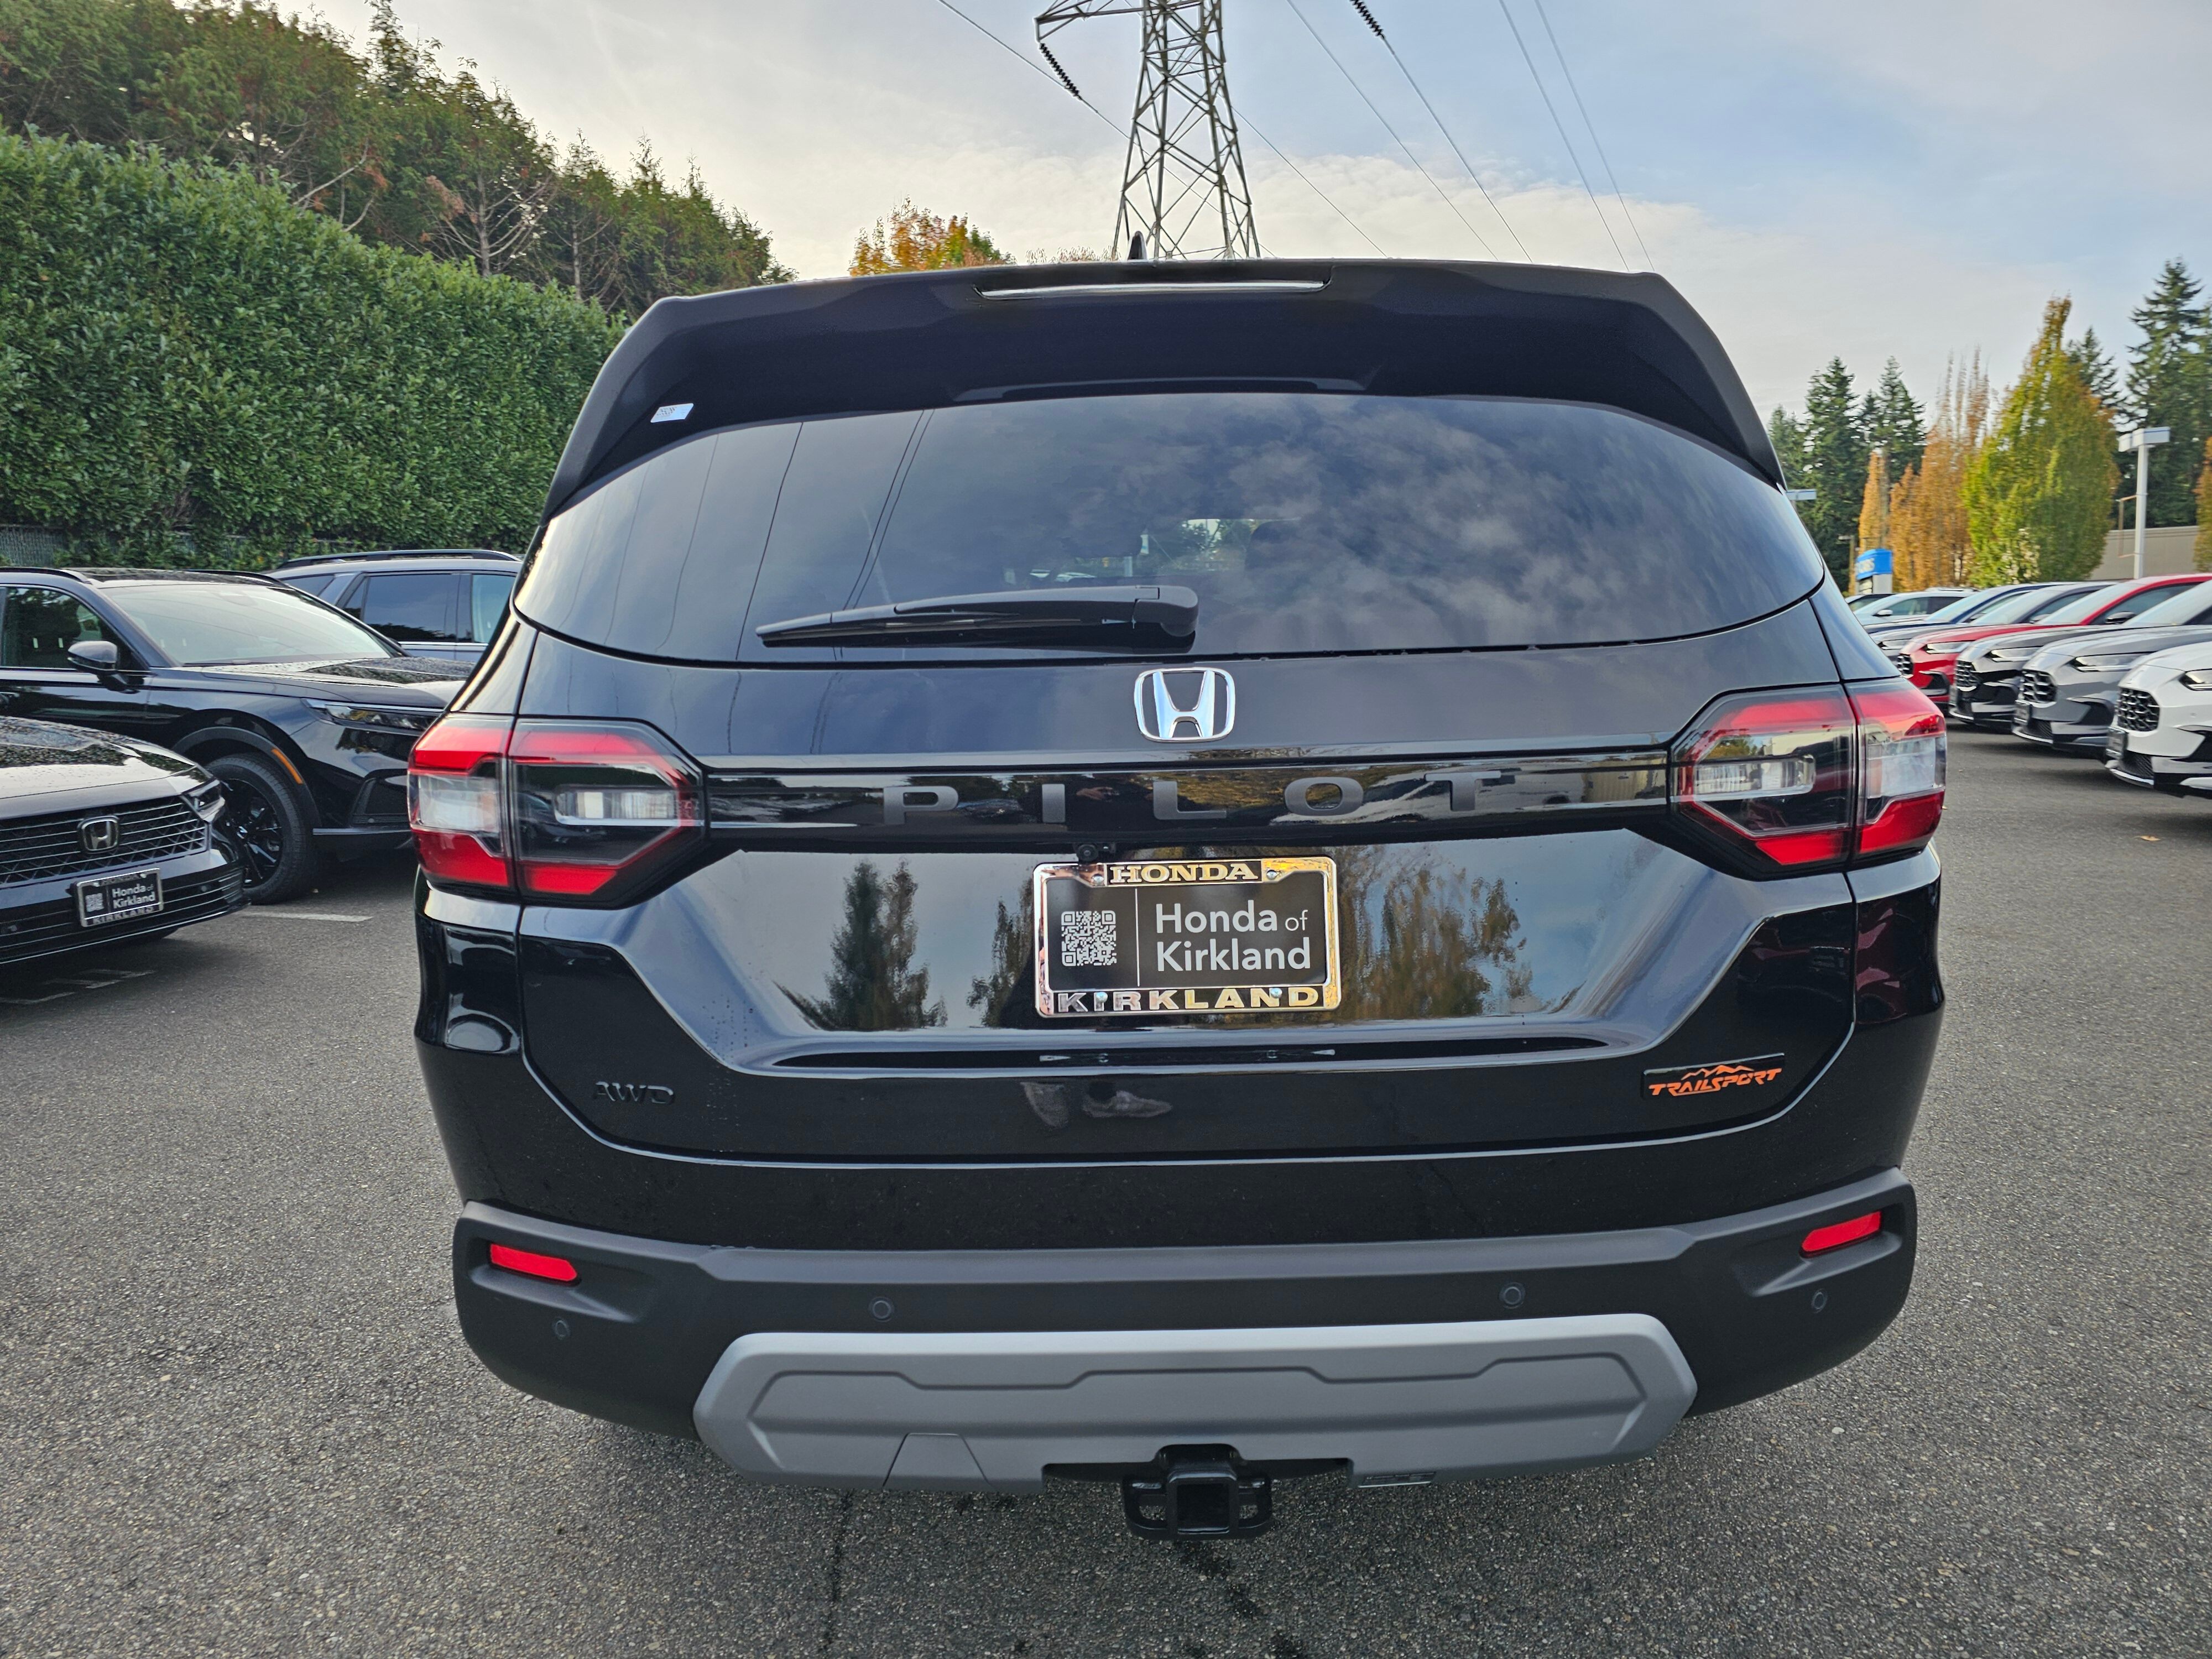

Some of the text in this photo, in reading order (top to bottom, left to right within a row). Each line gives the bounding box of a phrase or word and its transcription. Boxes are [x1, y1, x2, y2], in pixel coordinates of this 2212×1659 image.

[883, 770, 1501, 825] PILOT
[1109, 863, 1258, 884] HONDA
[111, 883, 146, 898] Honda
[112, 891, 155, 909] Kirkland
[1156, 900, 1308, 933] Honda of
[1157, 937, 1311, 972] Kirkland
[1058, 987, 1319, 1013] KIRKLAND
[593, 1081, 675, 1105] AWD
[1648, 1068, 1782, 1097] TRAILSPORT
